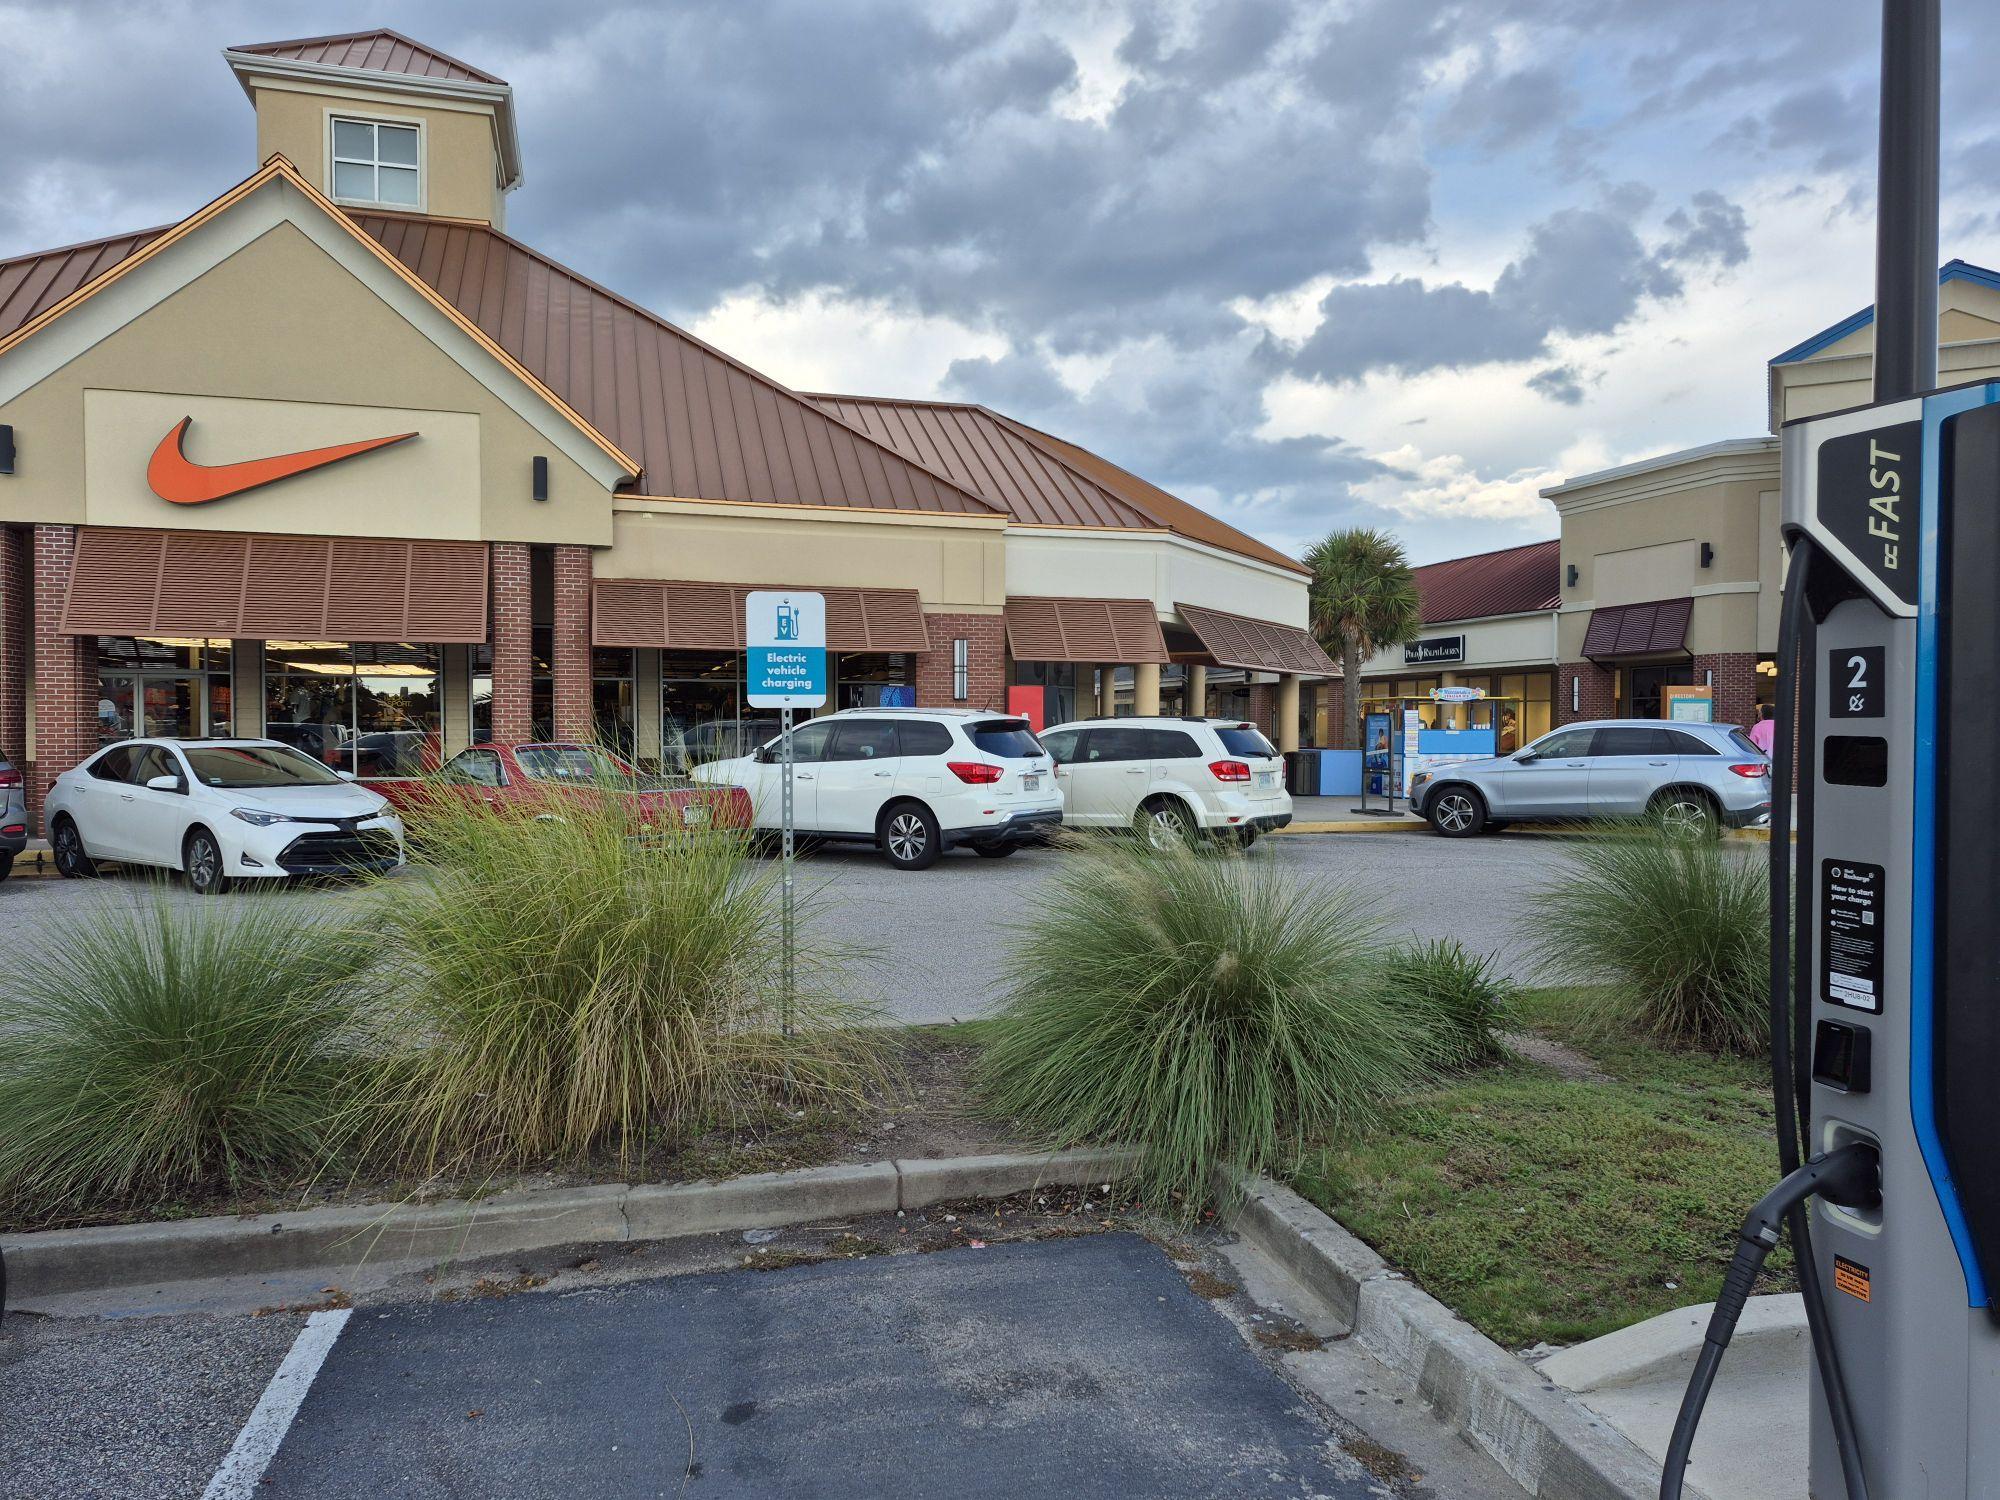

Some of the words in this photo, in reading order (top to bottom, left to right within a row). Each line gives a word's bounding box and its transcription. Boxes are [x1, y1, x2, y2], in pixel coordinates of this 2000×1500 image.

[1868, 438, 1901, 541] FAST
[1440, 646, 1460, 656] LAUREN
[767, 653, 807, 663] Electric
[767, 665, 807, 675] vehicle
[1847, 655, 1867, 688] 2
[761, 677, 813, 690] charging
[1831, 884, 1848, 892] How
[1857, 889, 1874, 897] start
[1830, 893, 1847, 901] your
[1847, 894, 1872, 906] charge
